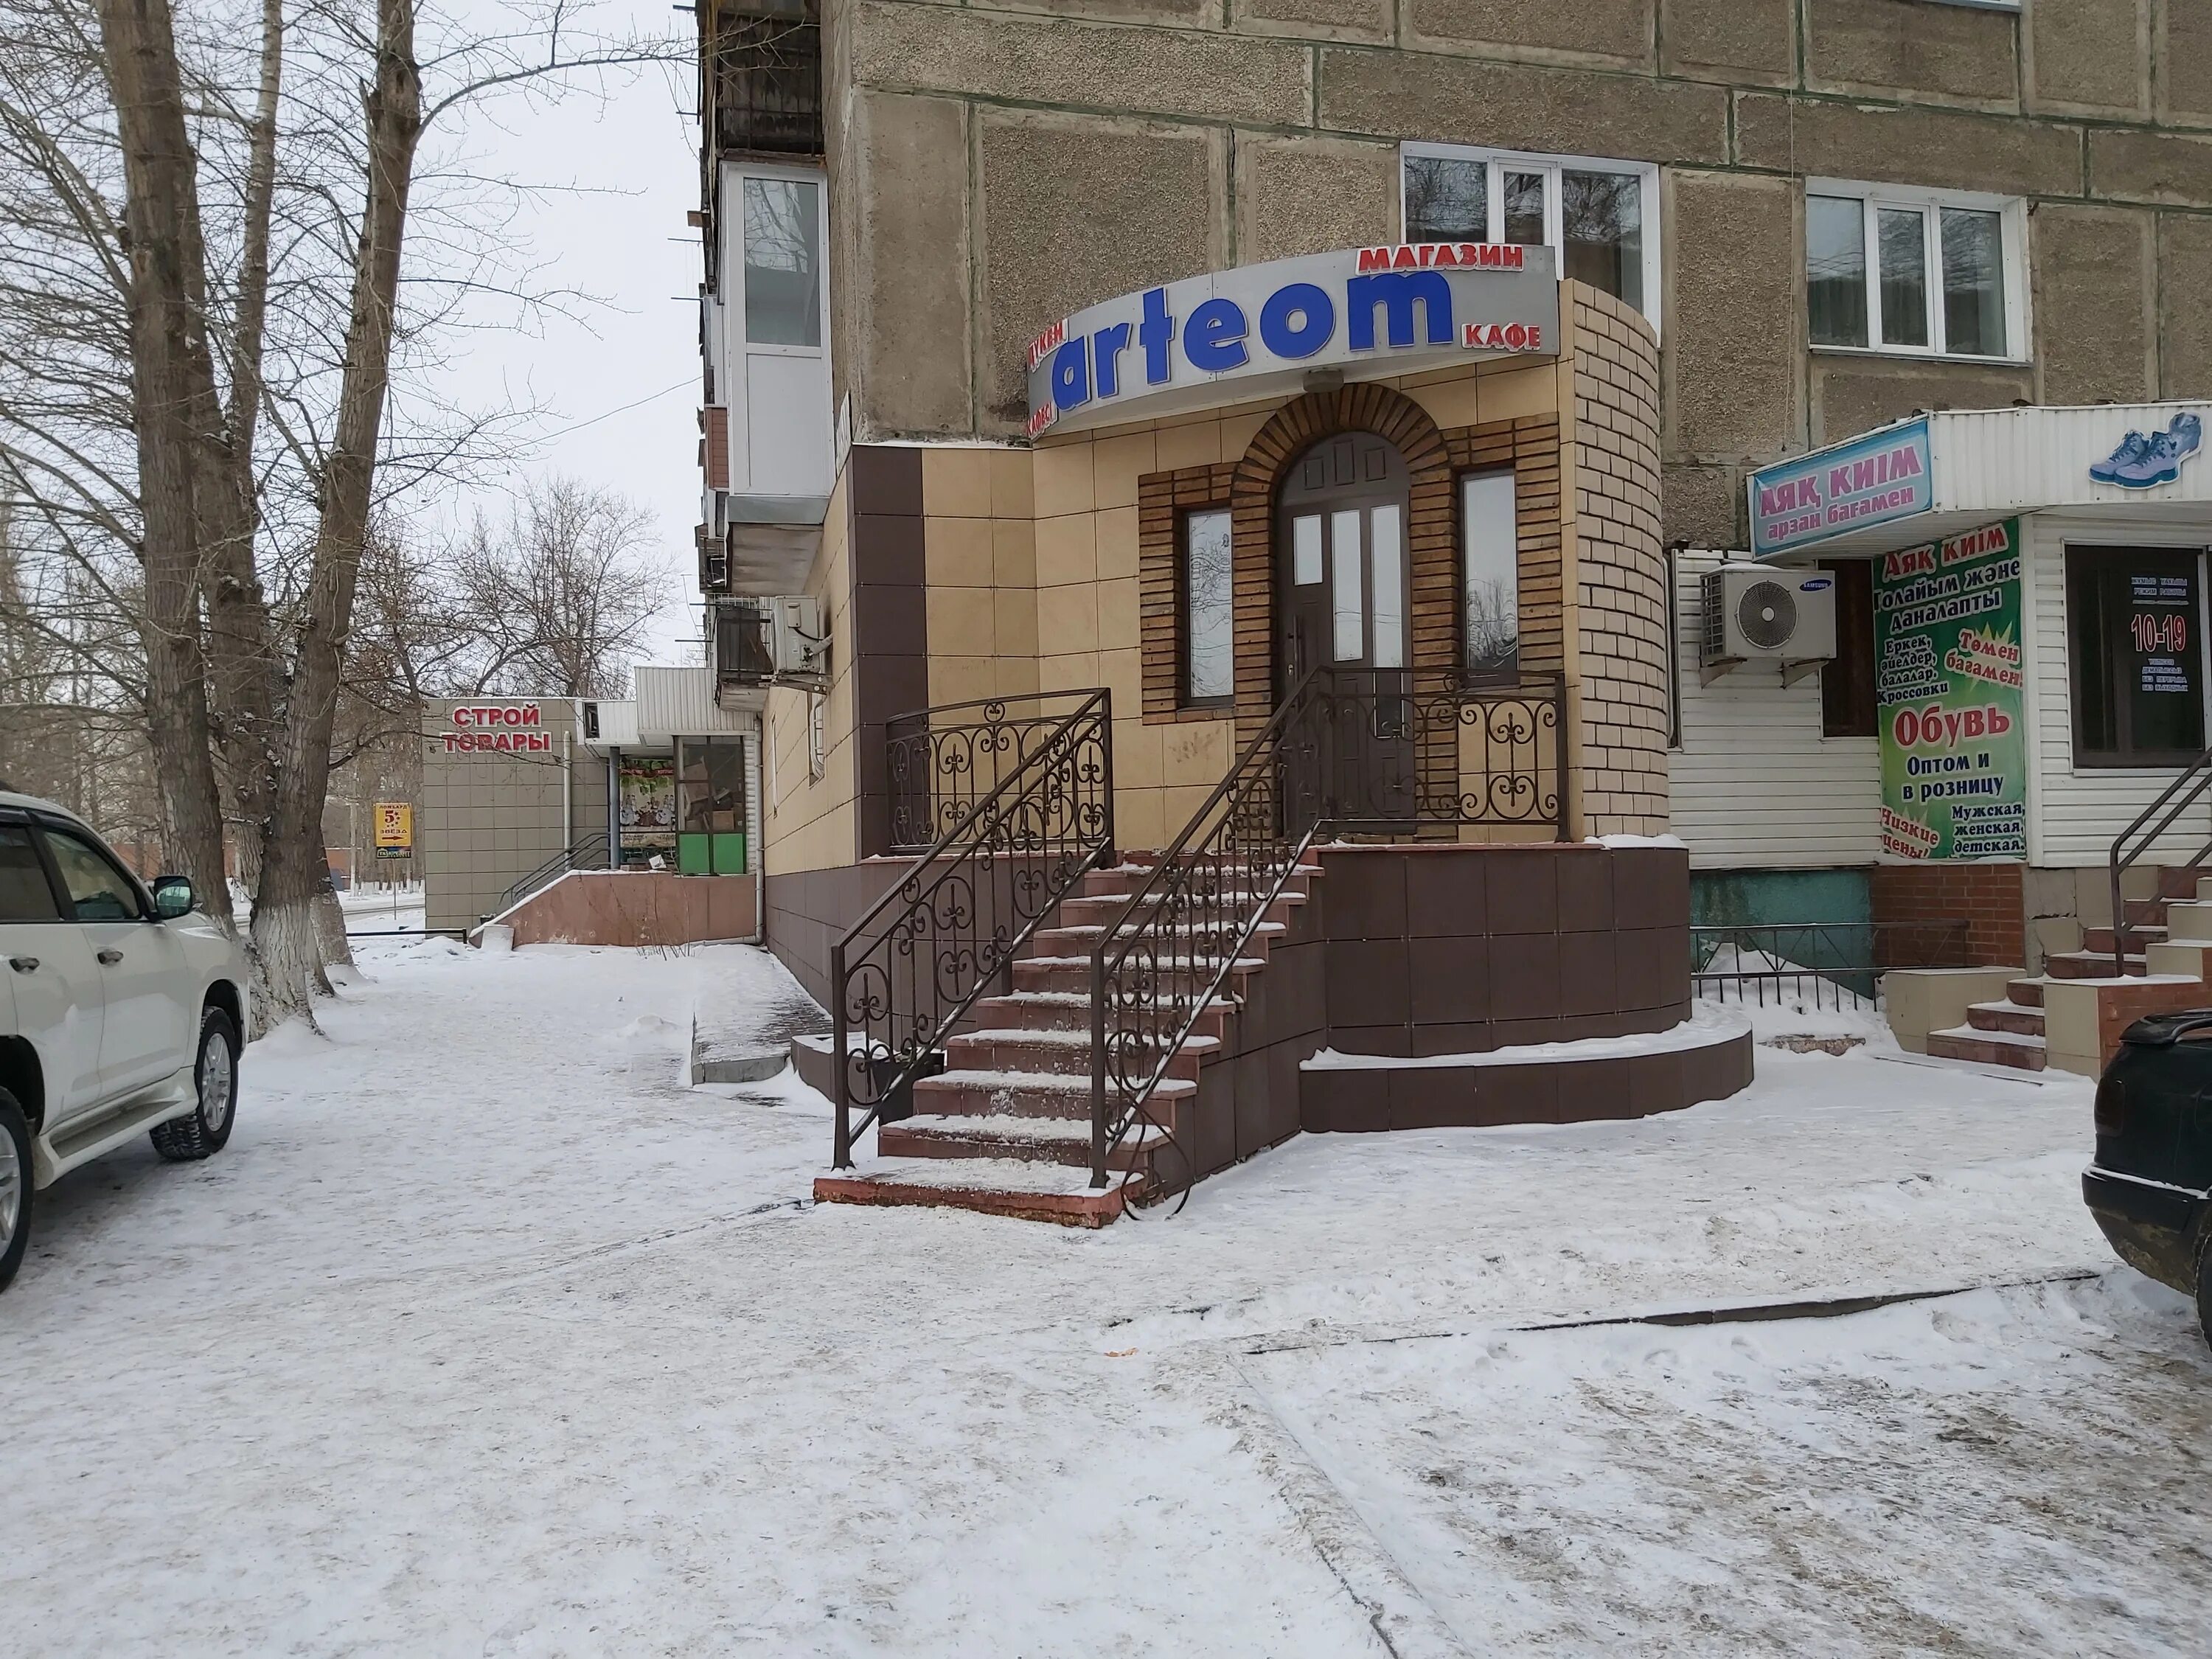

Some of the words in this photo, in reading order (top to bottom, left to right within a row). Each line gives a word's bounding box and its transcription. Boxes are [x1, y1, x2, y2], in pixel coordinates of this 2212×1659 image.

[1357, 244, 1523, 274] МАГАЗИН
[1051, 271, 1453, 411] arteom
[1463, 323, 1542, 351] КАФЕ
[1761, 476, 1822, 517] АЯҚ
[1829, 445, 1923, 498] КИІМ
[1768, 512, 1821, 540] арзан
[1885, 551, 1934, 579] Аяқ
[1941, 527, 2006, 563] киім
[1965, 560, 2020, 589] және
[1885, 637, 1932, 655] Еркек,
[1961, 631, 2020, 662] Төмен
[2131, 614, 2186, 652] 10-19
[1882, 668, 1937, 686] балалар.
[1877, 682, 1948, 704] Кроссовки
[453, 703, 540, 726] СТРОЙ
[1895, 706, 2010, 748] Обувь
[441, 733, 550, 752] ТОВАРЫ
[1907, 755, 1970, 775] Оптом
[1978, 753, 1989, 768] и
[1903, 785, 1913, 800] в
[1921, 776, 2004, 802] розницу
[384, 810, 395, 824] 5
[1881, 807, 1939, 846] Низкие
[1954, 821, 2024, 836] женская,
[1954, 839, 2025, 853] детская.
